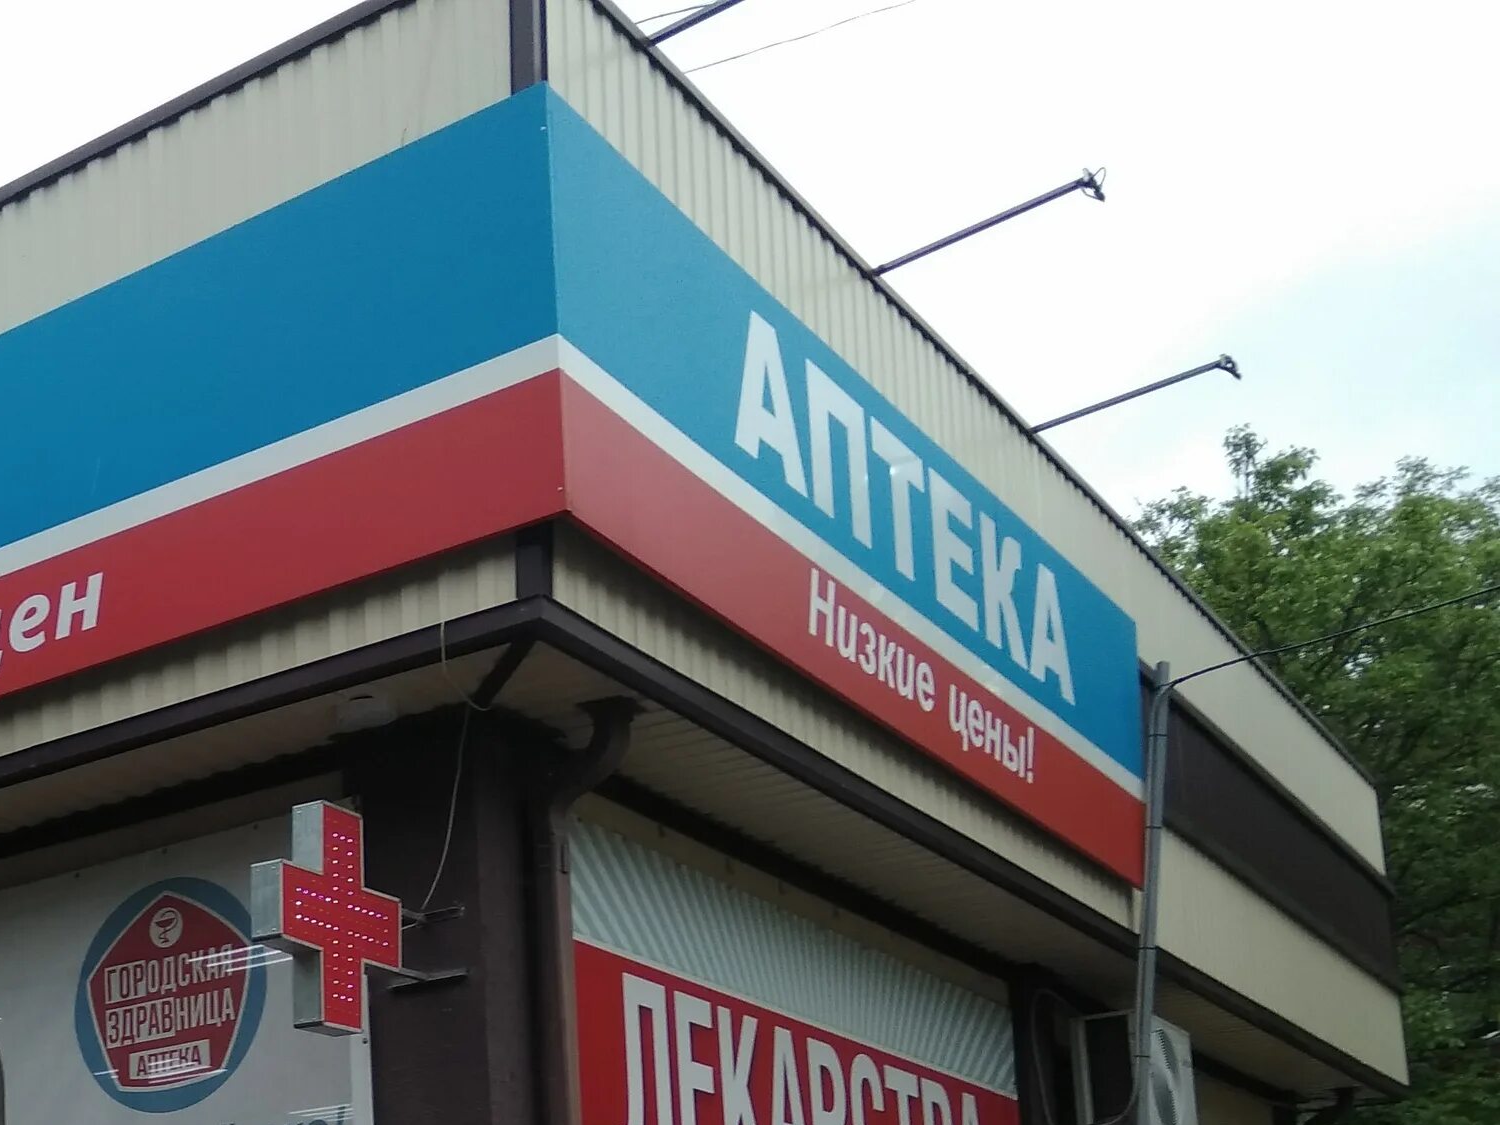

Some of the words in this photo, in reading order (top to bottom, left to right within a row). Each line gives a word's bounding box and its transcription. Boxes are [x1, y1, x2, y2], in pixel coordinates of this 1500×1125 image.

[734, 310, 1076, 706] АПТЕКА
[808, 567, 936, 713] Низкие
[949, 683, 1034, 784] цены!
[105, 943, 233, 1003] ГОРОДСКАЯ
[106, 987, 236, 1045] ЗДРАВНИЦА
[136, 1045, 202, 1077] АПТЕКА
